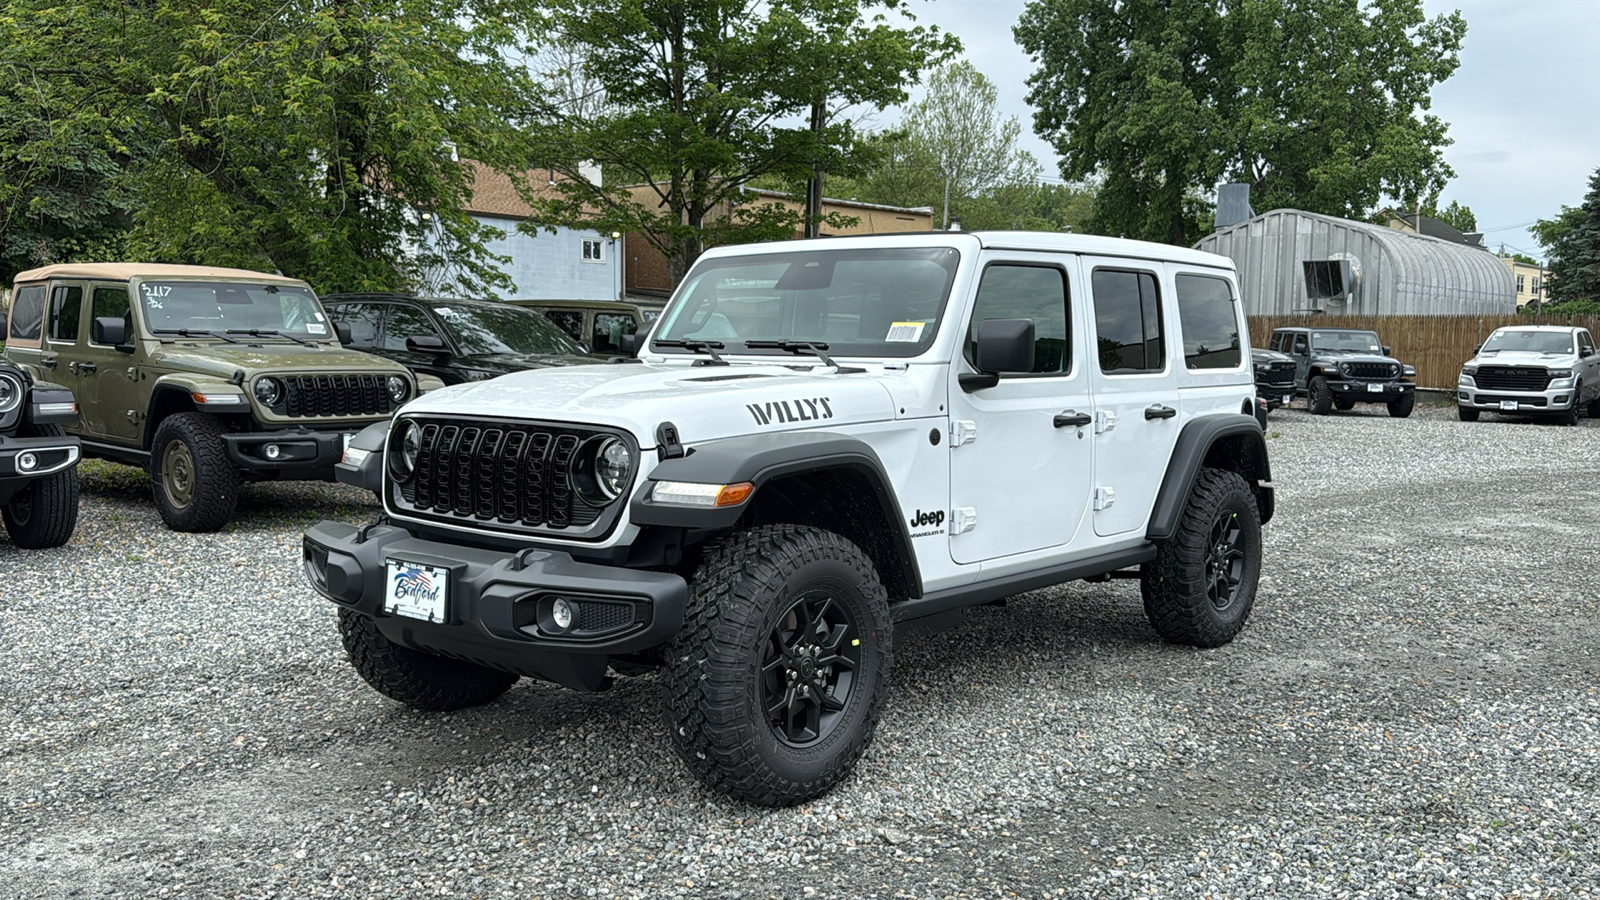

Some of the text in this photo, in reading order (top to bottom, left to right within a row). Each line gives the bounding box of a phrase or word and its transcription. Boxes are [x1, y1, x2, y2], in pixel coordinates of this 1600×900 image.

[745, 397, 833, 426] WILLYS
[910, 509, 945, 528] Jeep
[910, 530, 939, 539] WRANGLER
[394, 573, 440, 605] Bedford
